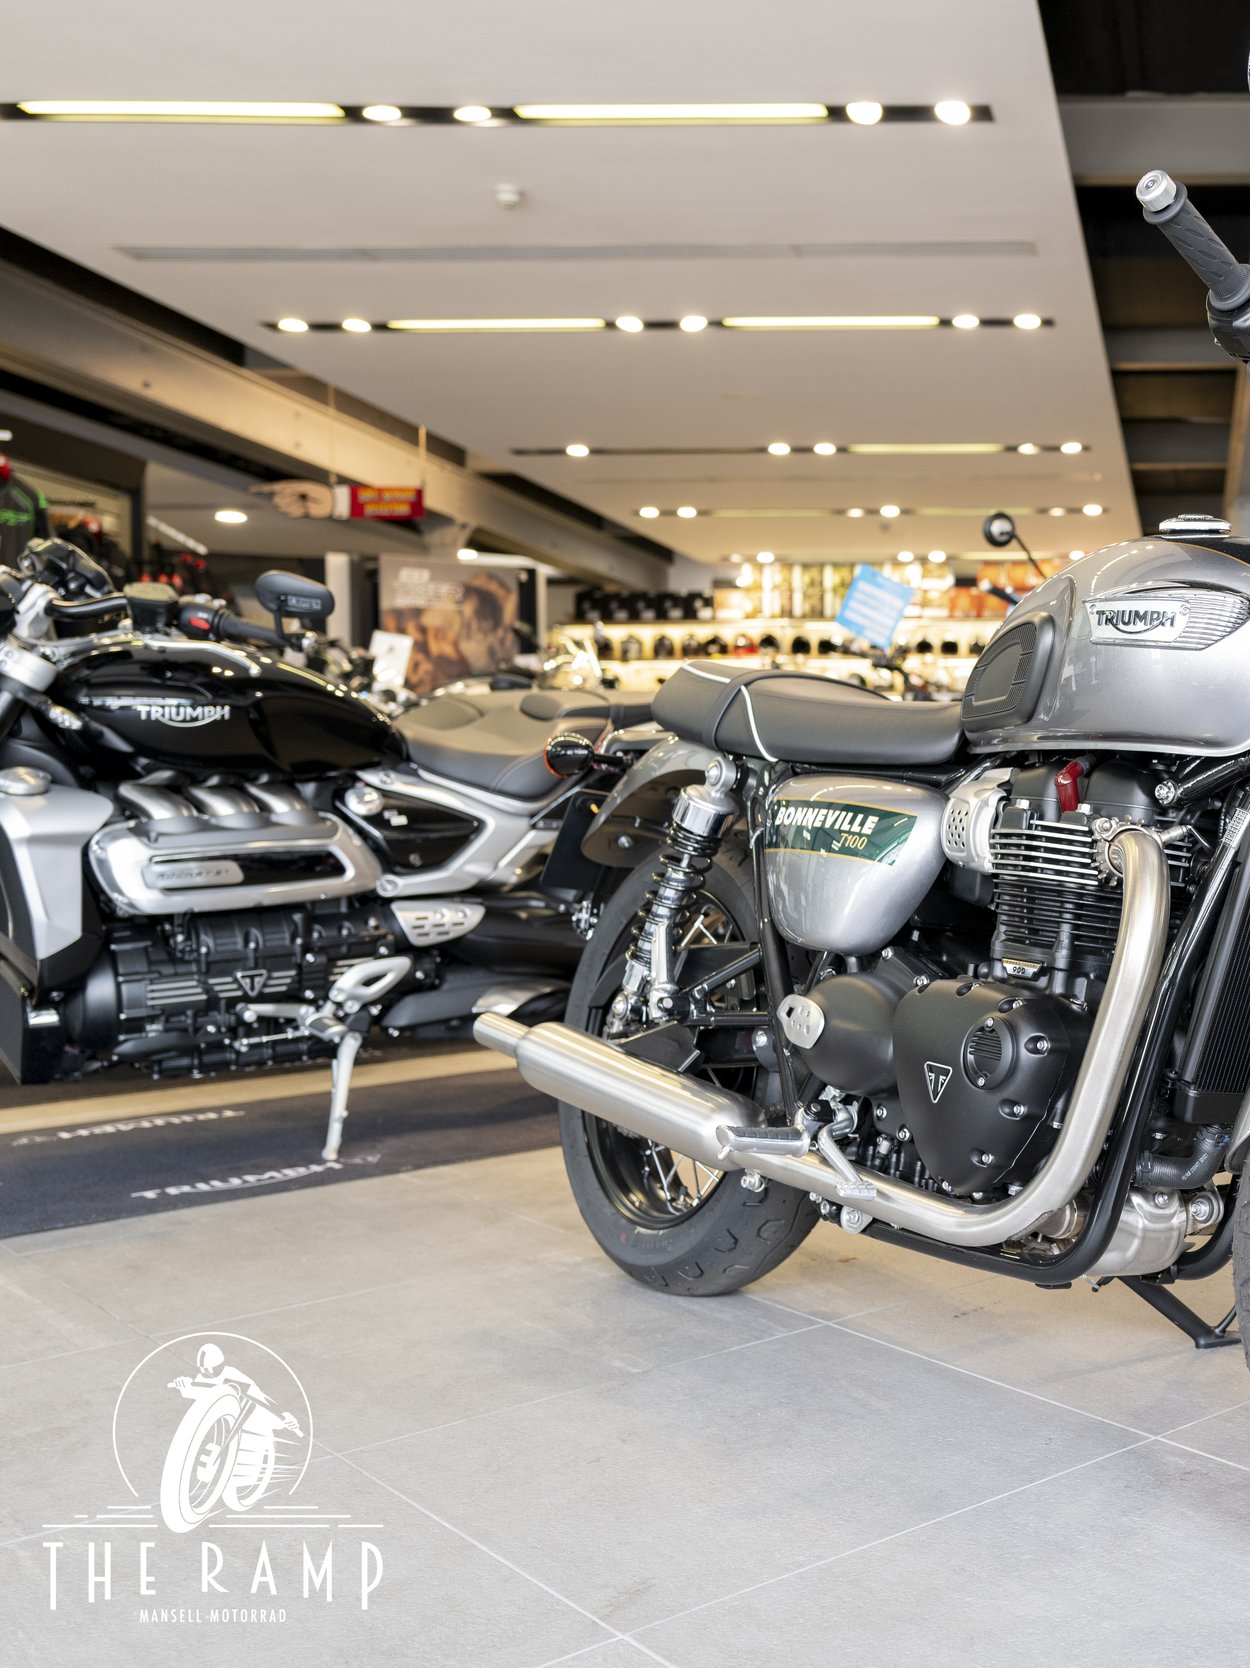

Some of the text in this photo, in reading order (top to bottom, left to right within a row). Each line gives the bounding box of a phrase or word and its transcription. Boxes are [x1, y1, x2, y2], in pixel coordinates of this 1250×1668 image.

[1095, 609, 1177, 635] TRIUMPH
[133, 704, 231, 728] TRIUMPH
[774, 806, 880, 835] BONNEVILLE
[839, 832, 869, 850] T100
[57, 1109, 245, 1140] TRIUMPH
[130, 1160, 344, 1200] TRIUMPH
